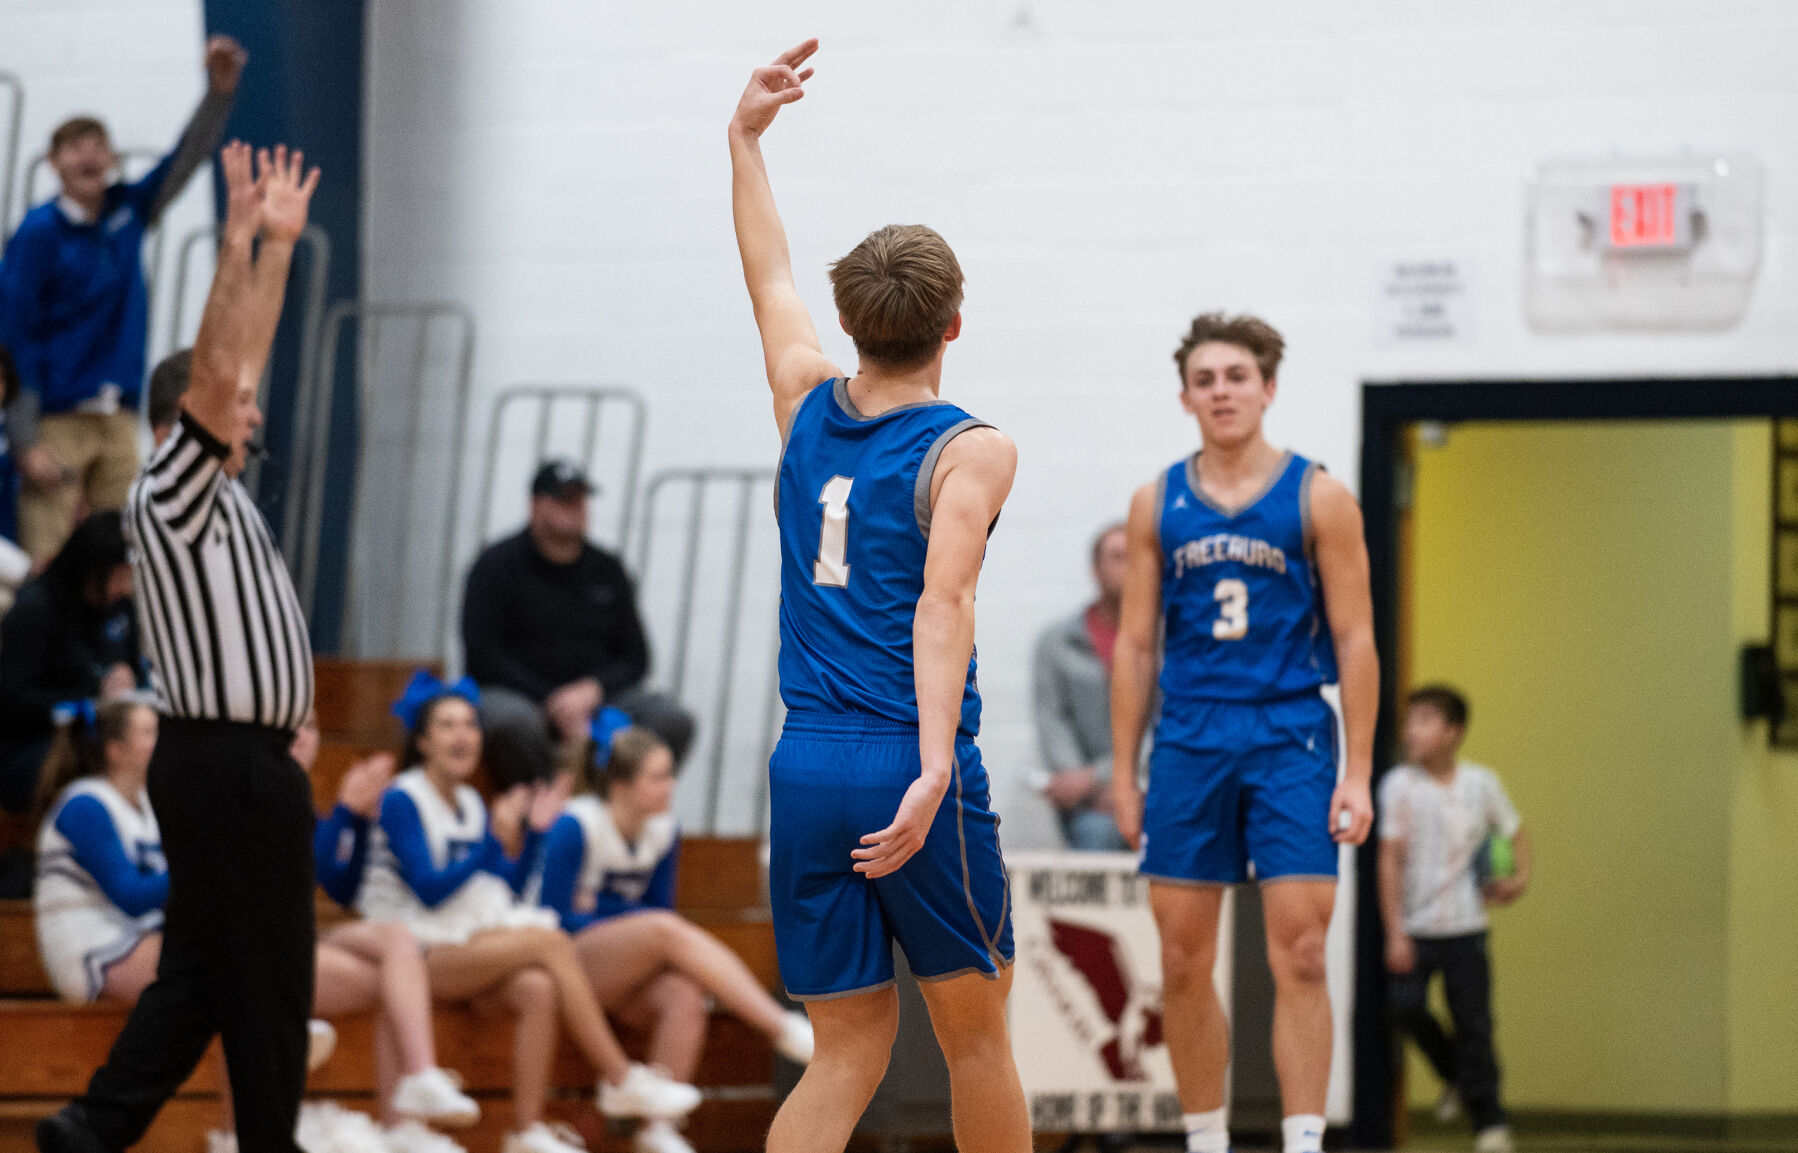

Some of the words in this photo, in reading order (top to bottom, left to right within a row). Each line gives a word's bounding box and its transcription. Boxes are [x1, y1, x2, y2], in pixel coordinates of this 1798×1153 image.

[1610, 184, 1676, 247] EXIT
[813, 474, 854, 589] 1
[1212, 579, 1249, 640] 3
[1029, 870, 1106, 905] WELCOME
